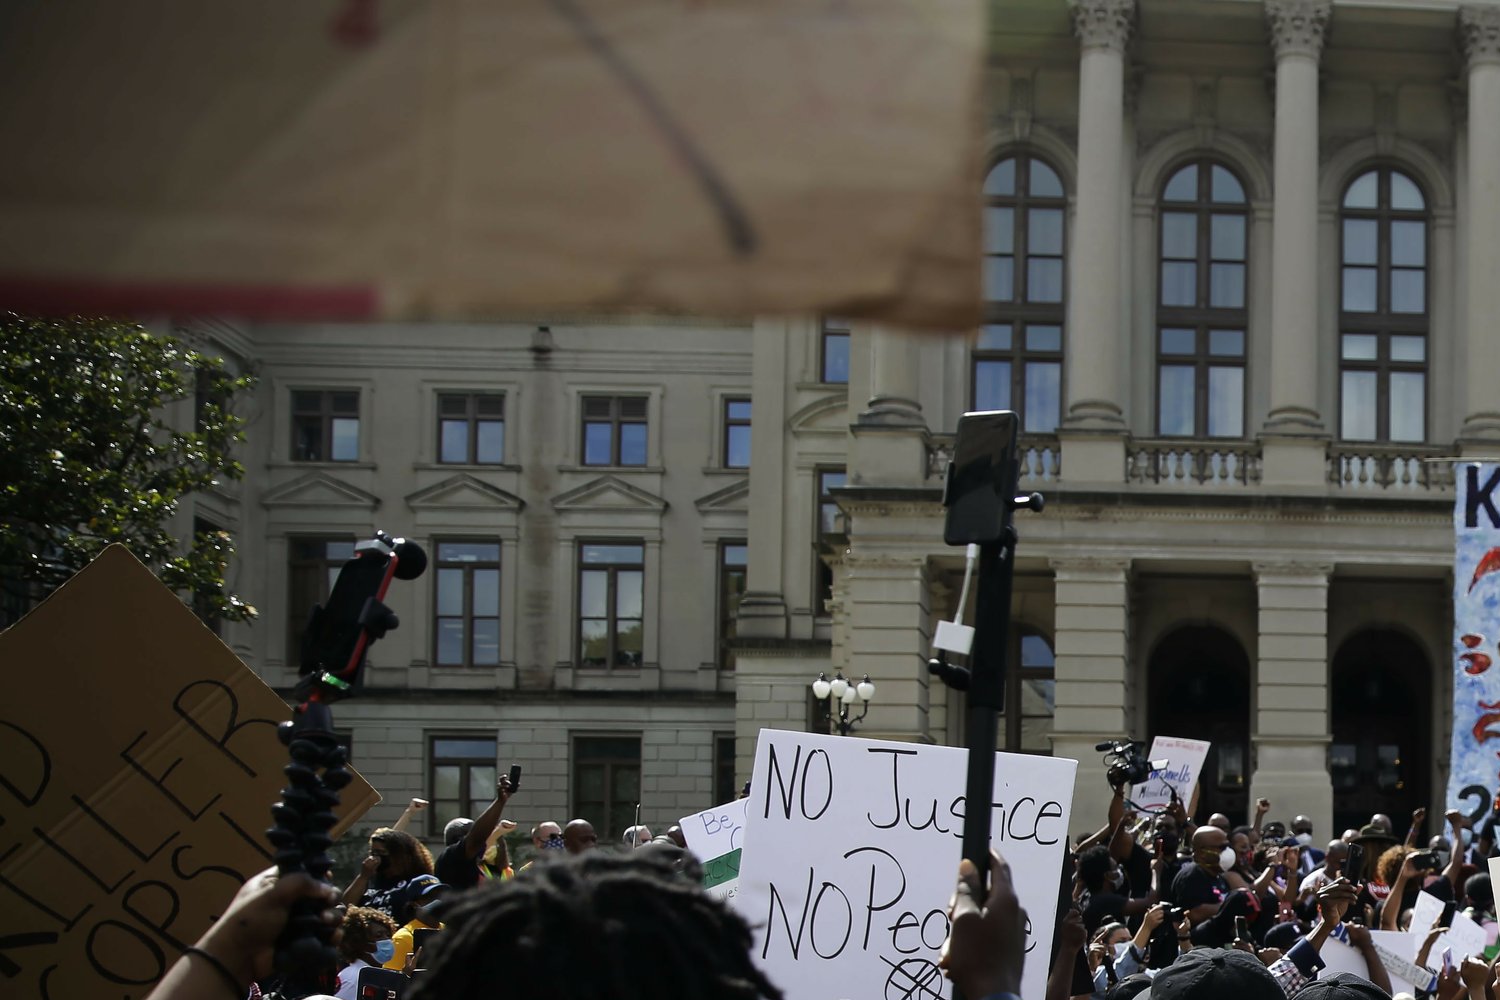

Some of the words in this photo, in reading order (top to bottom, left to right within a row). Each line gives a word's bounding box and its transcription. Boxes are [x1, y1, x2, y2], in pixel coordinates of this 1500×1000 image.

[699, 812, 734, 835] Be
[764, 743, 833, 821] NO
[867, 747, 1064, 846] Jusice
[762, 866, 853, 961] NO
